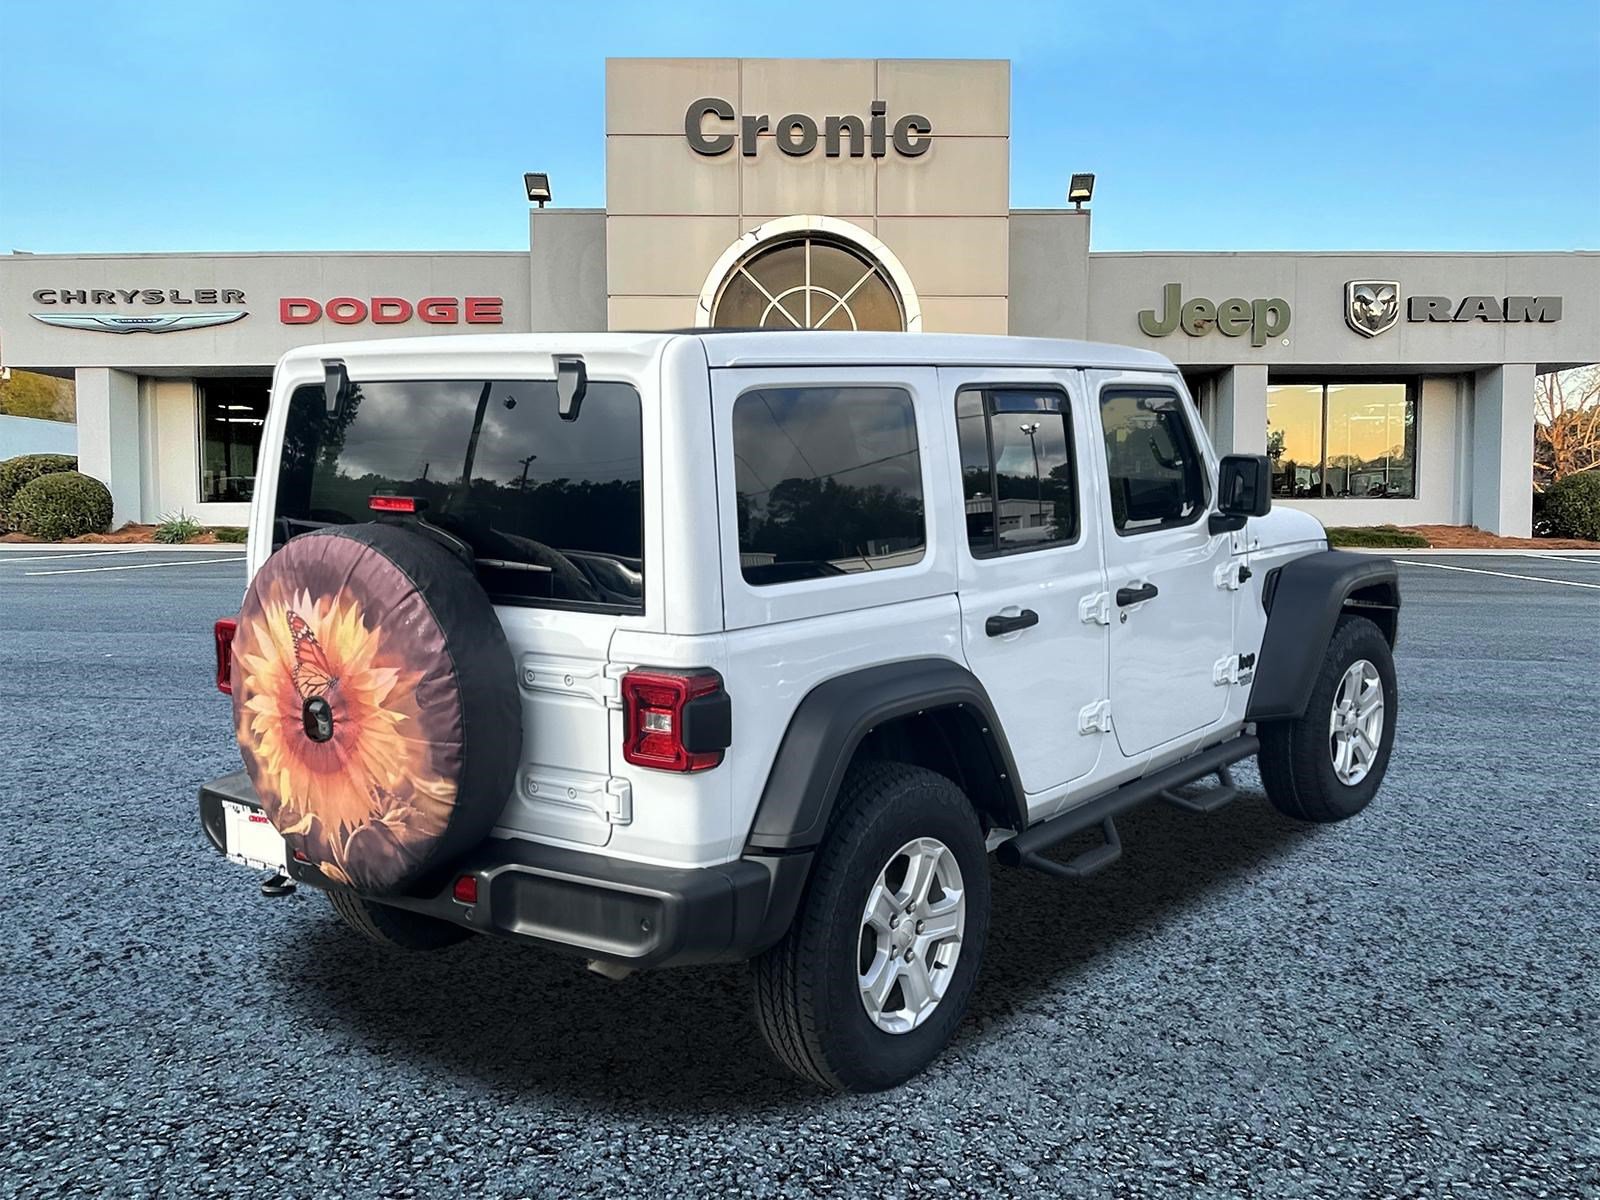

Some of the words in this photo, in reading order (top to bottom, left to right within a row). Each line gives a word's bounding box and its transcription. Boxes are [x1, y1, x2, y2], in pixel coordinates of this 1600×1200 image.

[685, 98, 932, 158] Cronic
[32, 289, 247, 305] CHRYSLER
[279, 297, 504, 324] DODGE
[1407, 296, 1563, 322] RAM
[1138, 283, 1292, 348] Jeep
